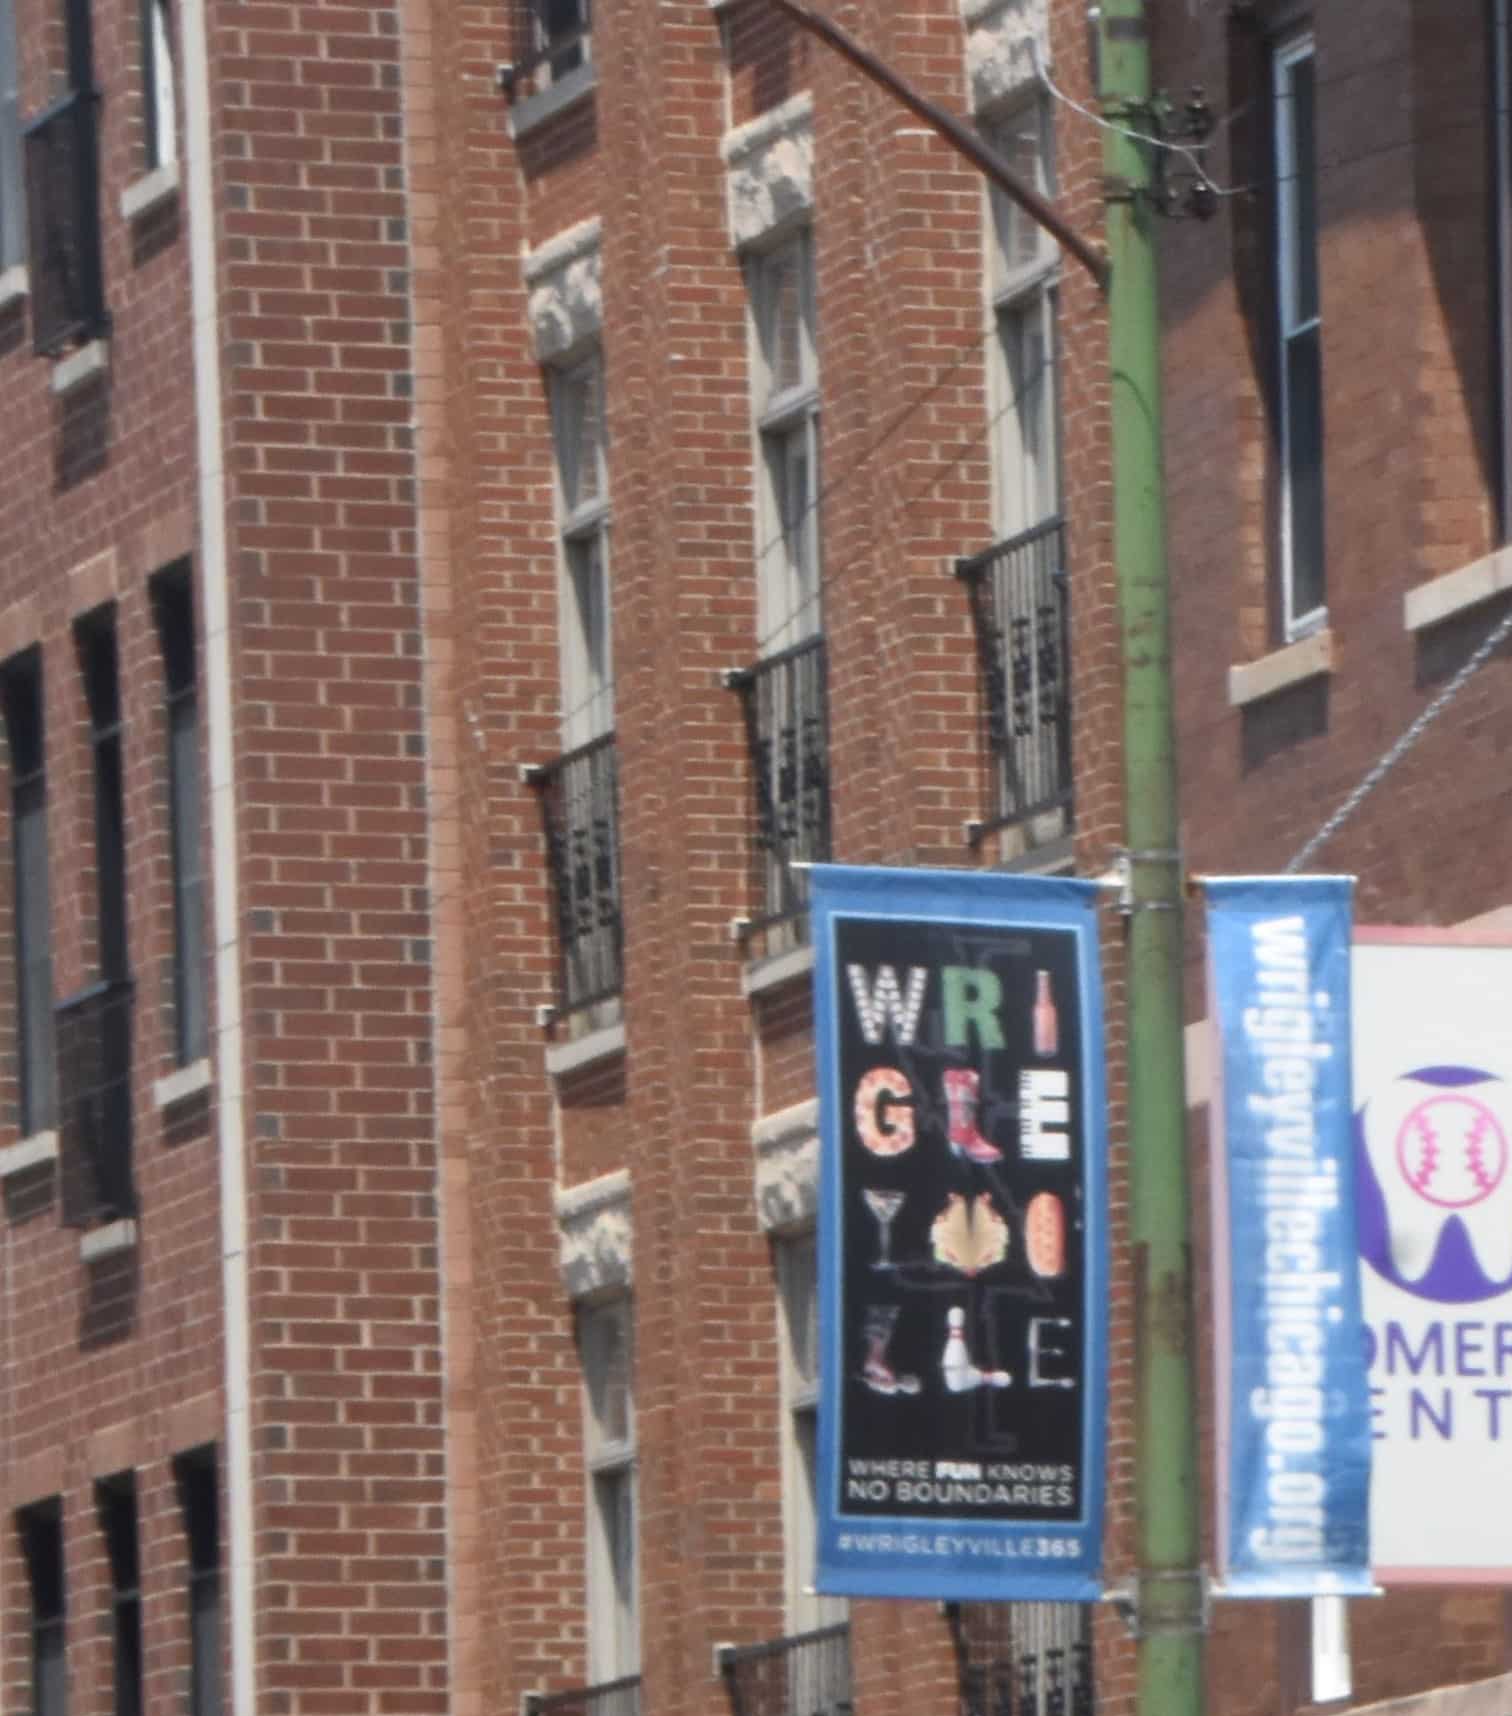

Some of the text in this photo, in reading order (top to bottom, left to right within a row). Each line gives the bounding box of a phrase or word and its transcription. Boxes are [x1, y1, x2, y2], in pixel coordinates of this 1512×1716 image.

[1242, 914, 1343, 1563] wrigleyvillechicago.org
[848, 1459, 1074, 1482] WHERE FUN KNOWS
[848, 1480, 1074, 1507] NO BOUNDARIES
[838, 1533, 1081, 1558] #WRIGLEYVILLE365
